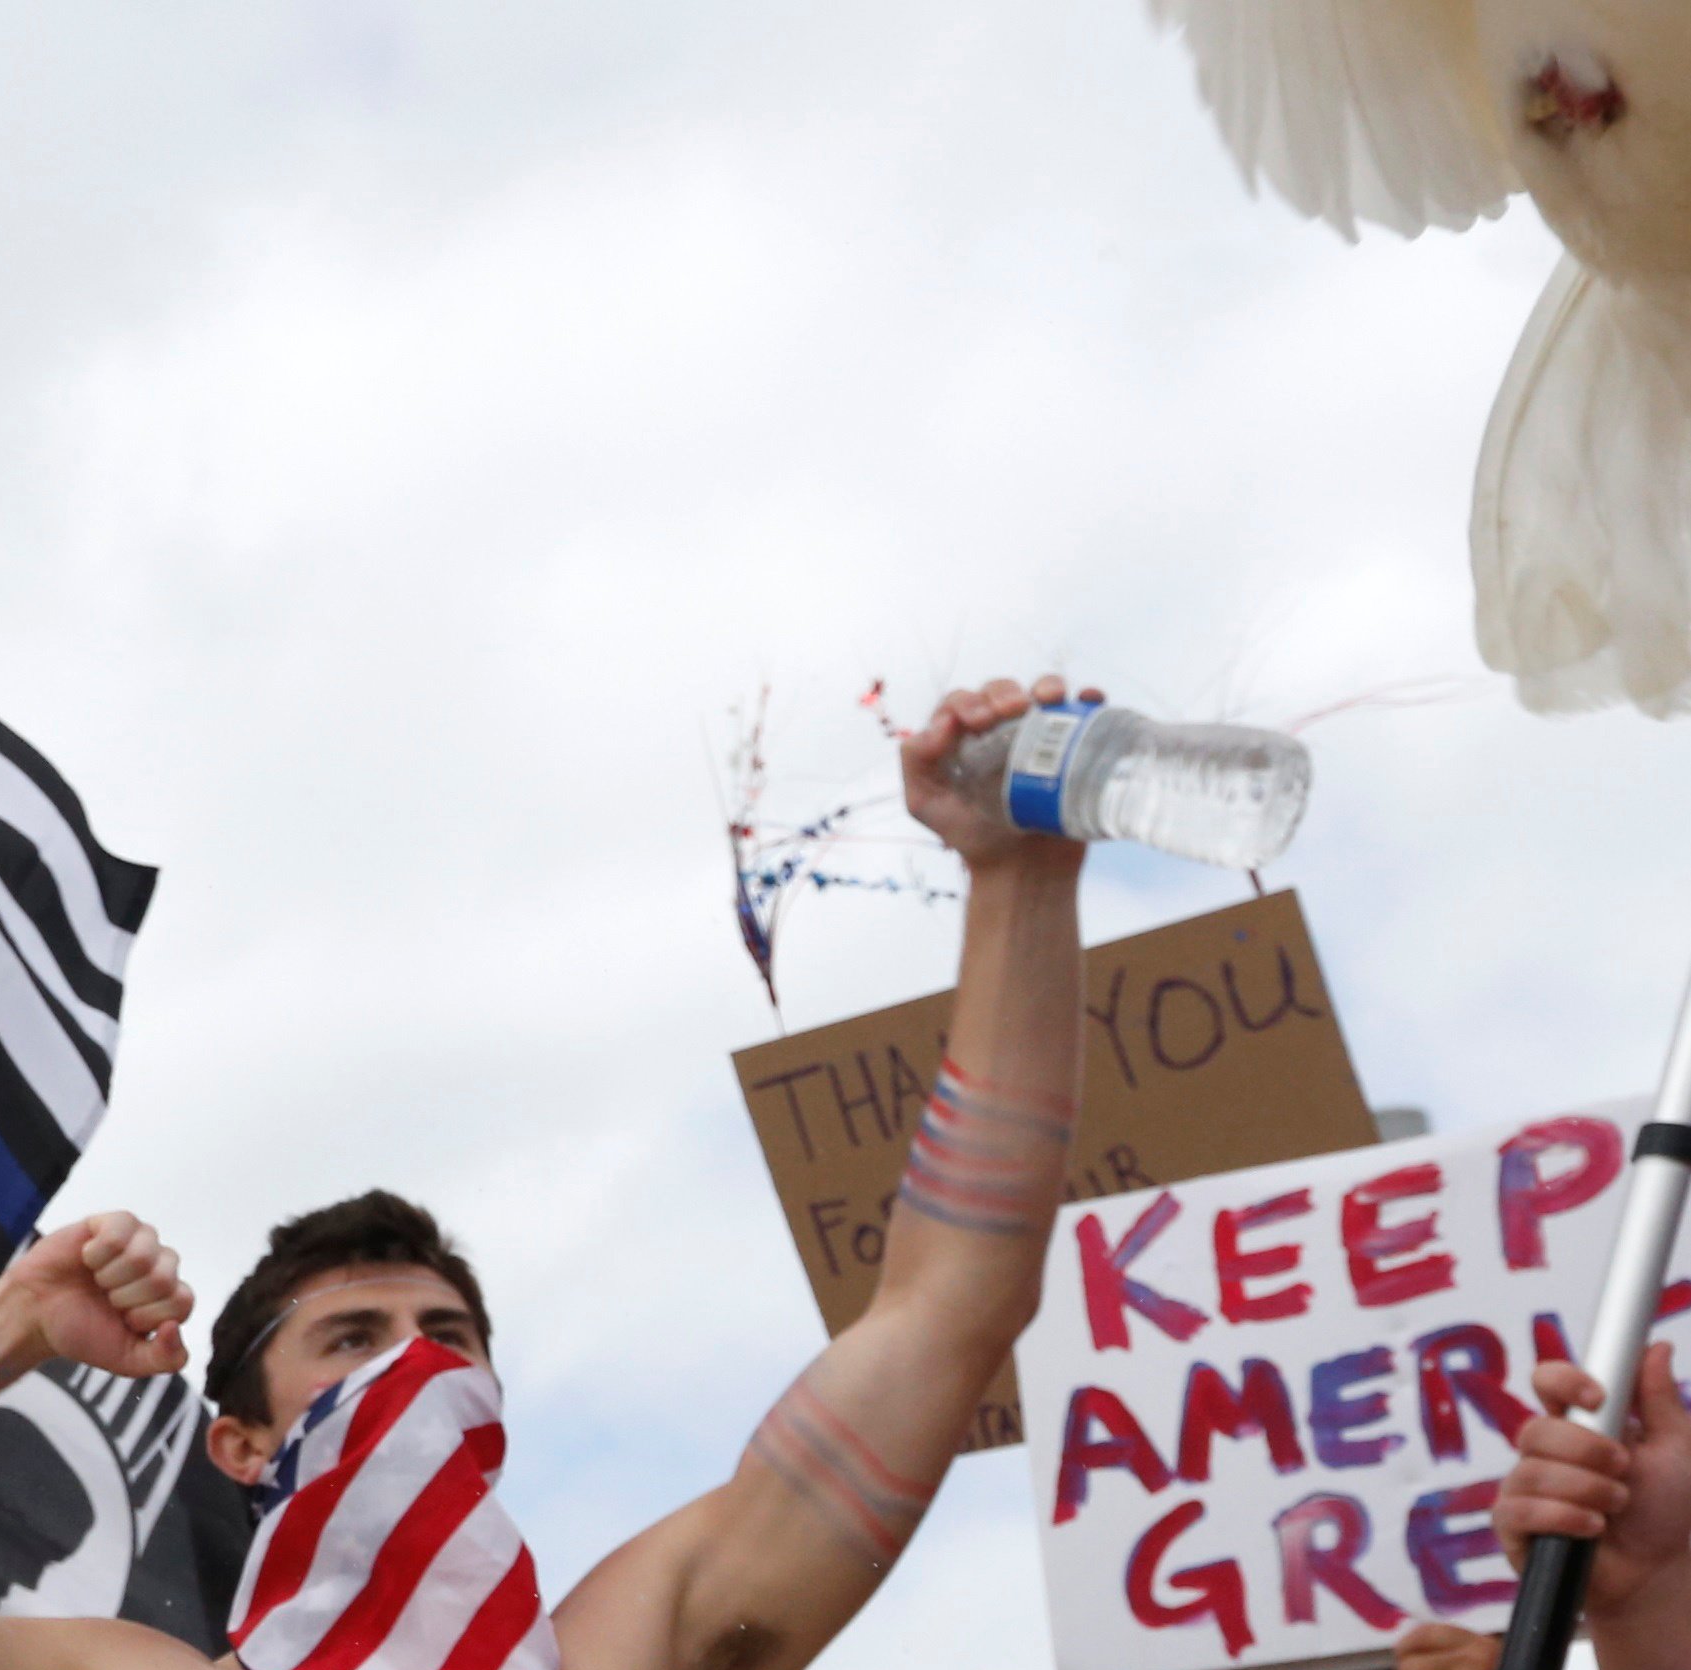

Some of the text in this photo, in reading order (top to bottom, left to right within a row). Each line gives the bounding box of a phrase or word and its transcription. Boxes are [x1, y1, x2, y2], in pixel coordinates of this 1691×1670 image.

[752, 944, 1324, 1163] THA YOU
[1075, 1114, 1624, 1352] KEEP
